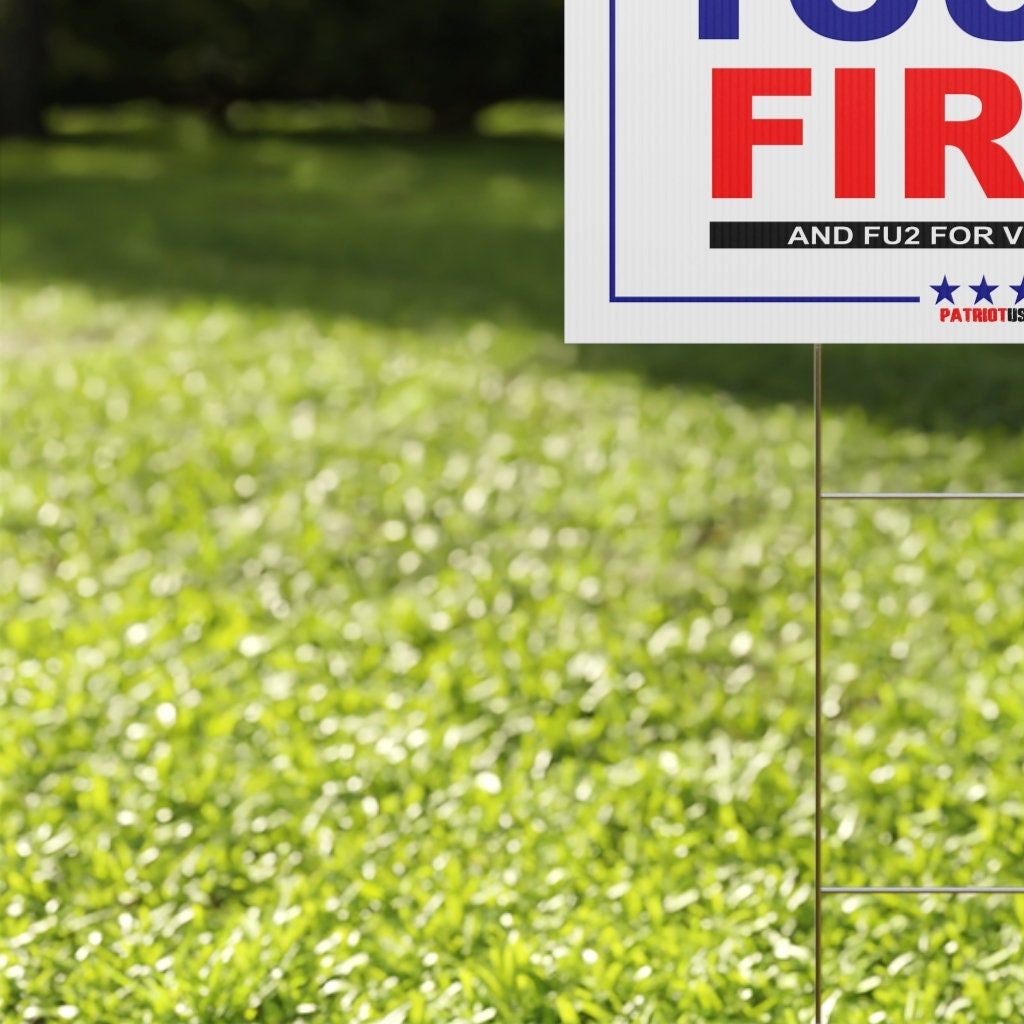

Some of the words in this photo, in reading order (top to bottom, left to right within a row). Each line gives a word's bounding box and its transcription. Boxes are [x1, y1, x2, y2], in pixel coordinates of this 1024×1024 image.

[787, 225, 854, 245] AND
[864, 225, 920, 245] FU2
[931, 225, 995, 245] FOR
